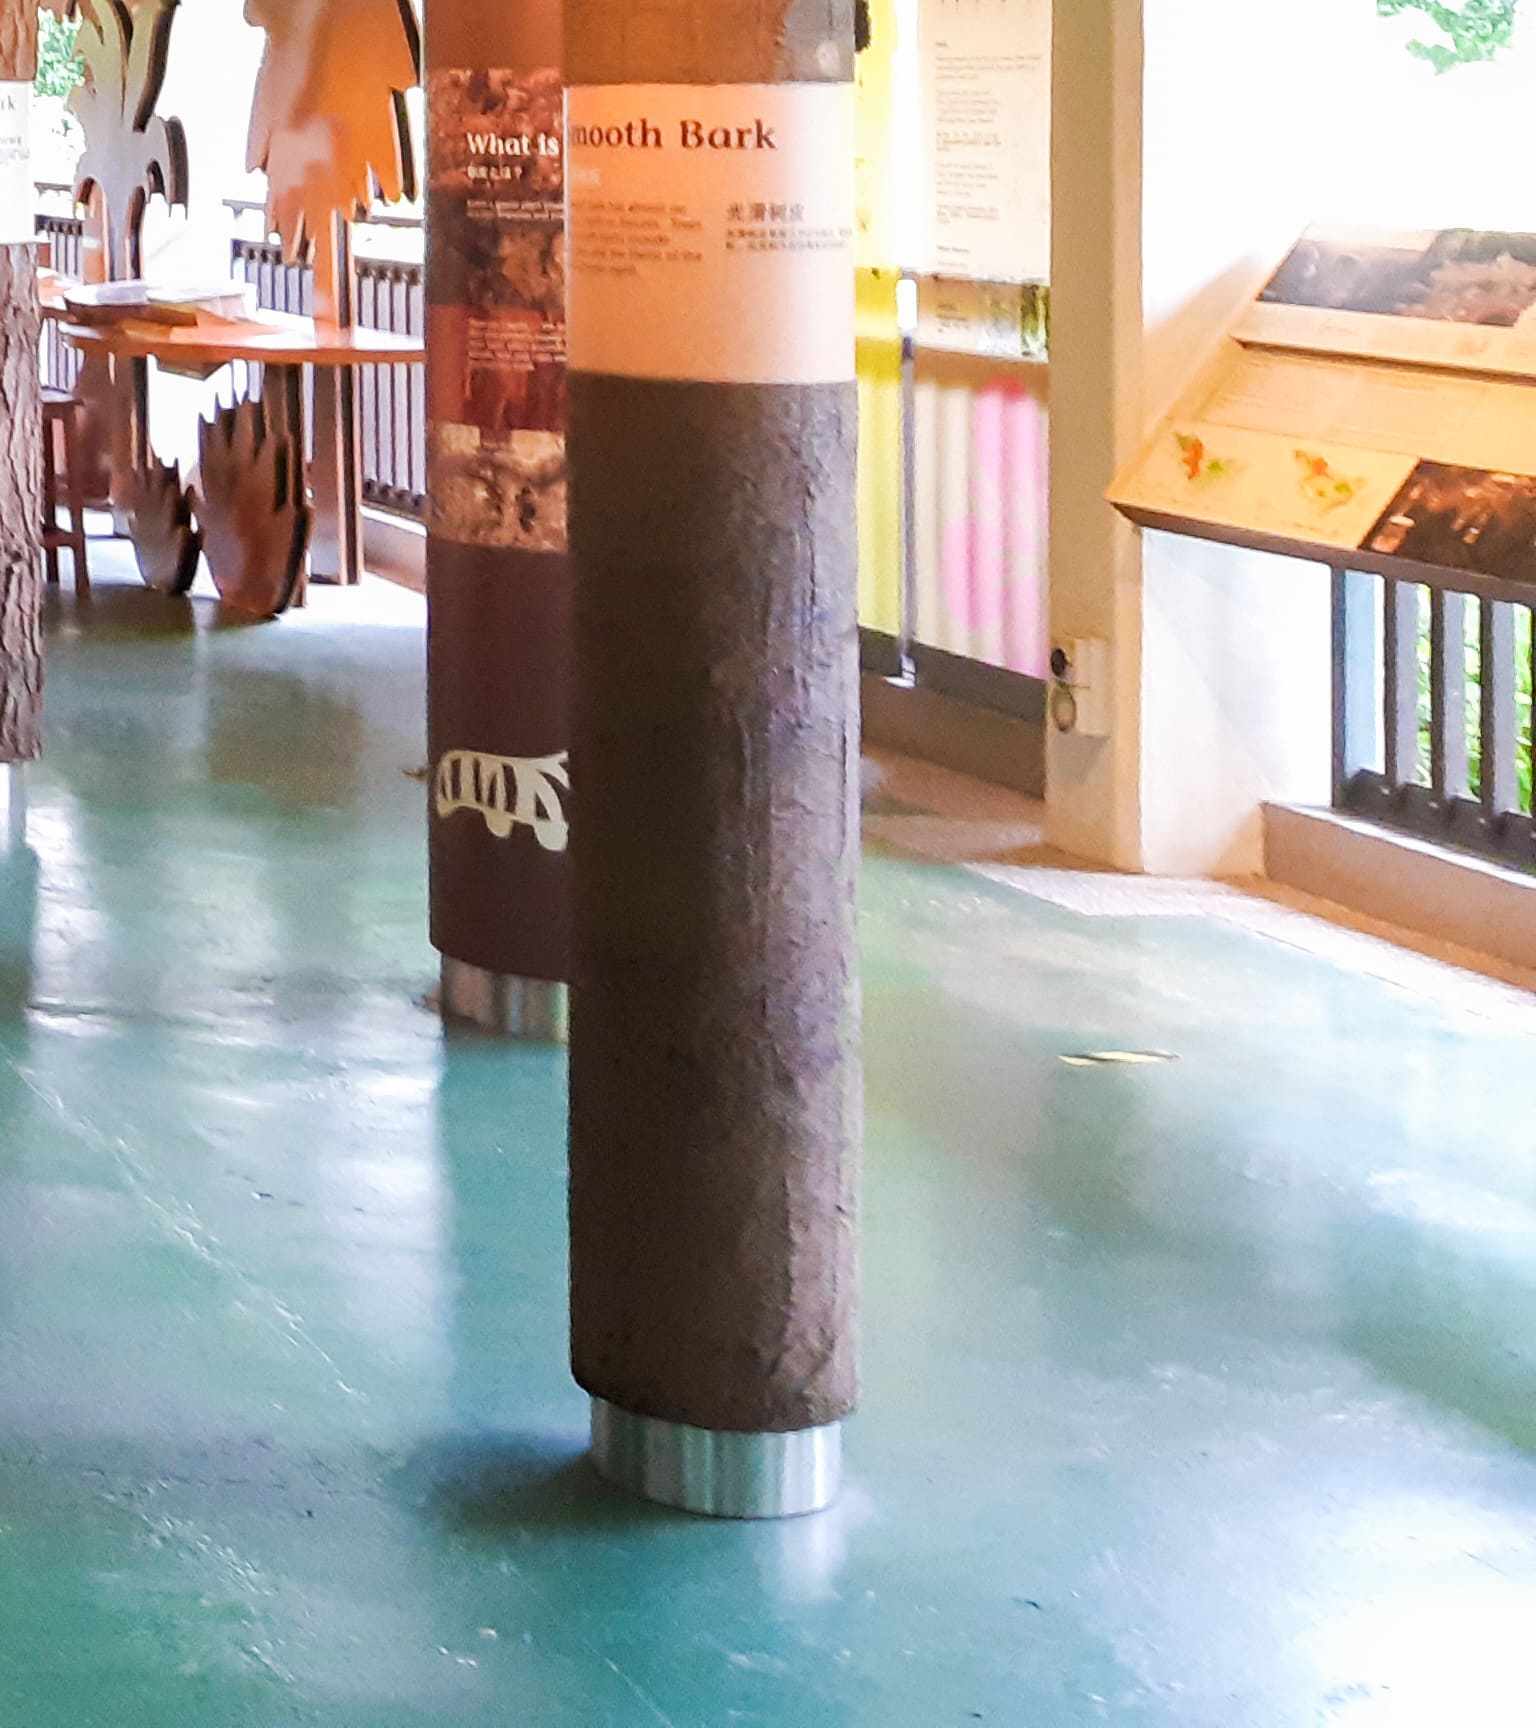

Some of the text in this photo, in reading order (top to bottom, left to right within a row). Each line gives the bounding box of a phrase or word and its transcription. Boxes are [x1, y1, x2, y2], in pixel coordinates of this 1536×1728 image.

[466, 131, 531, 156] What
[569, 118, 777, 150] mooth Bark
